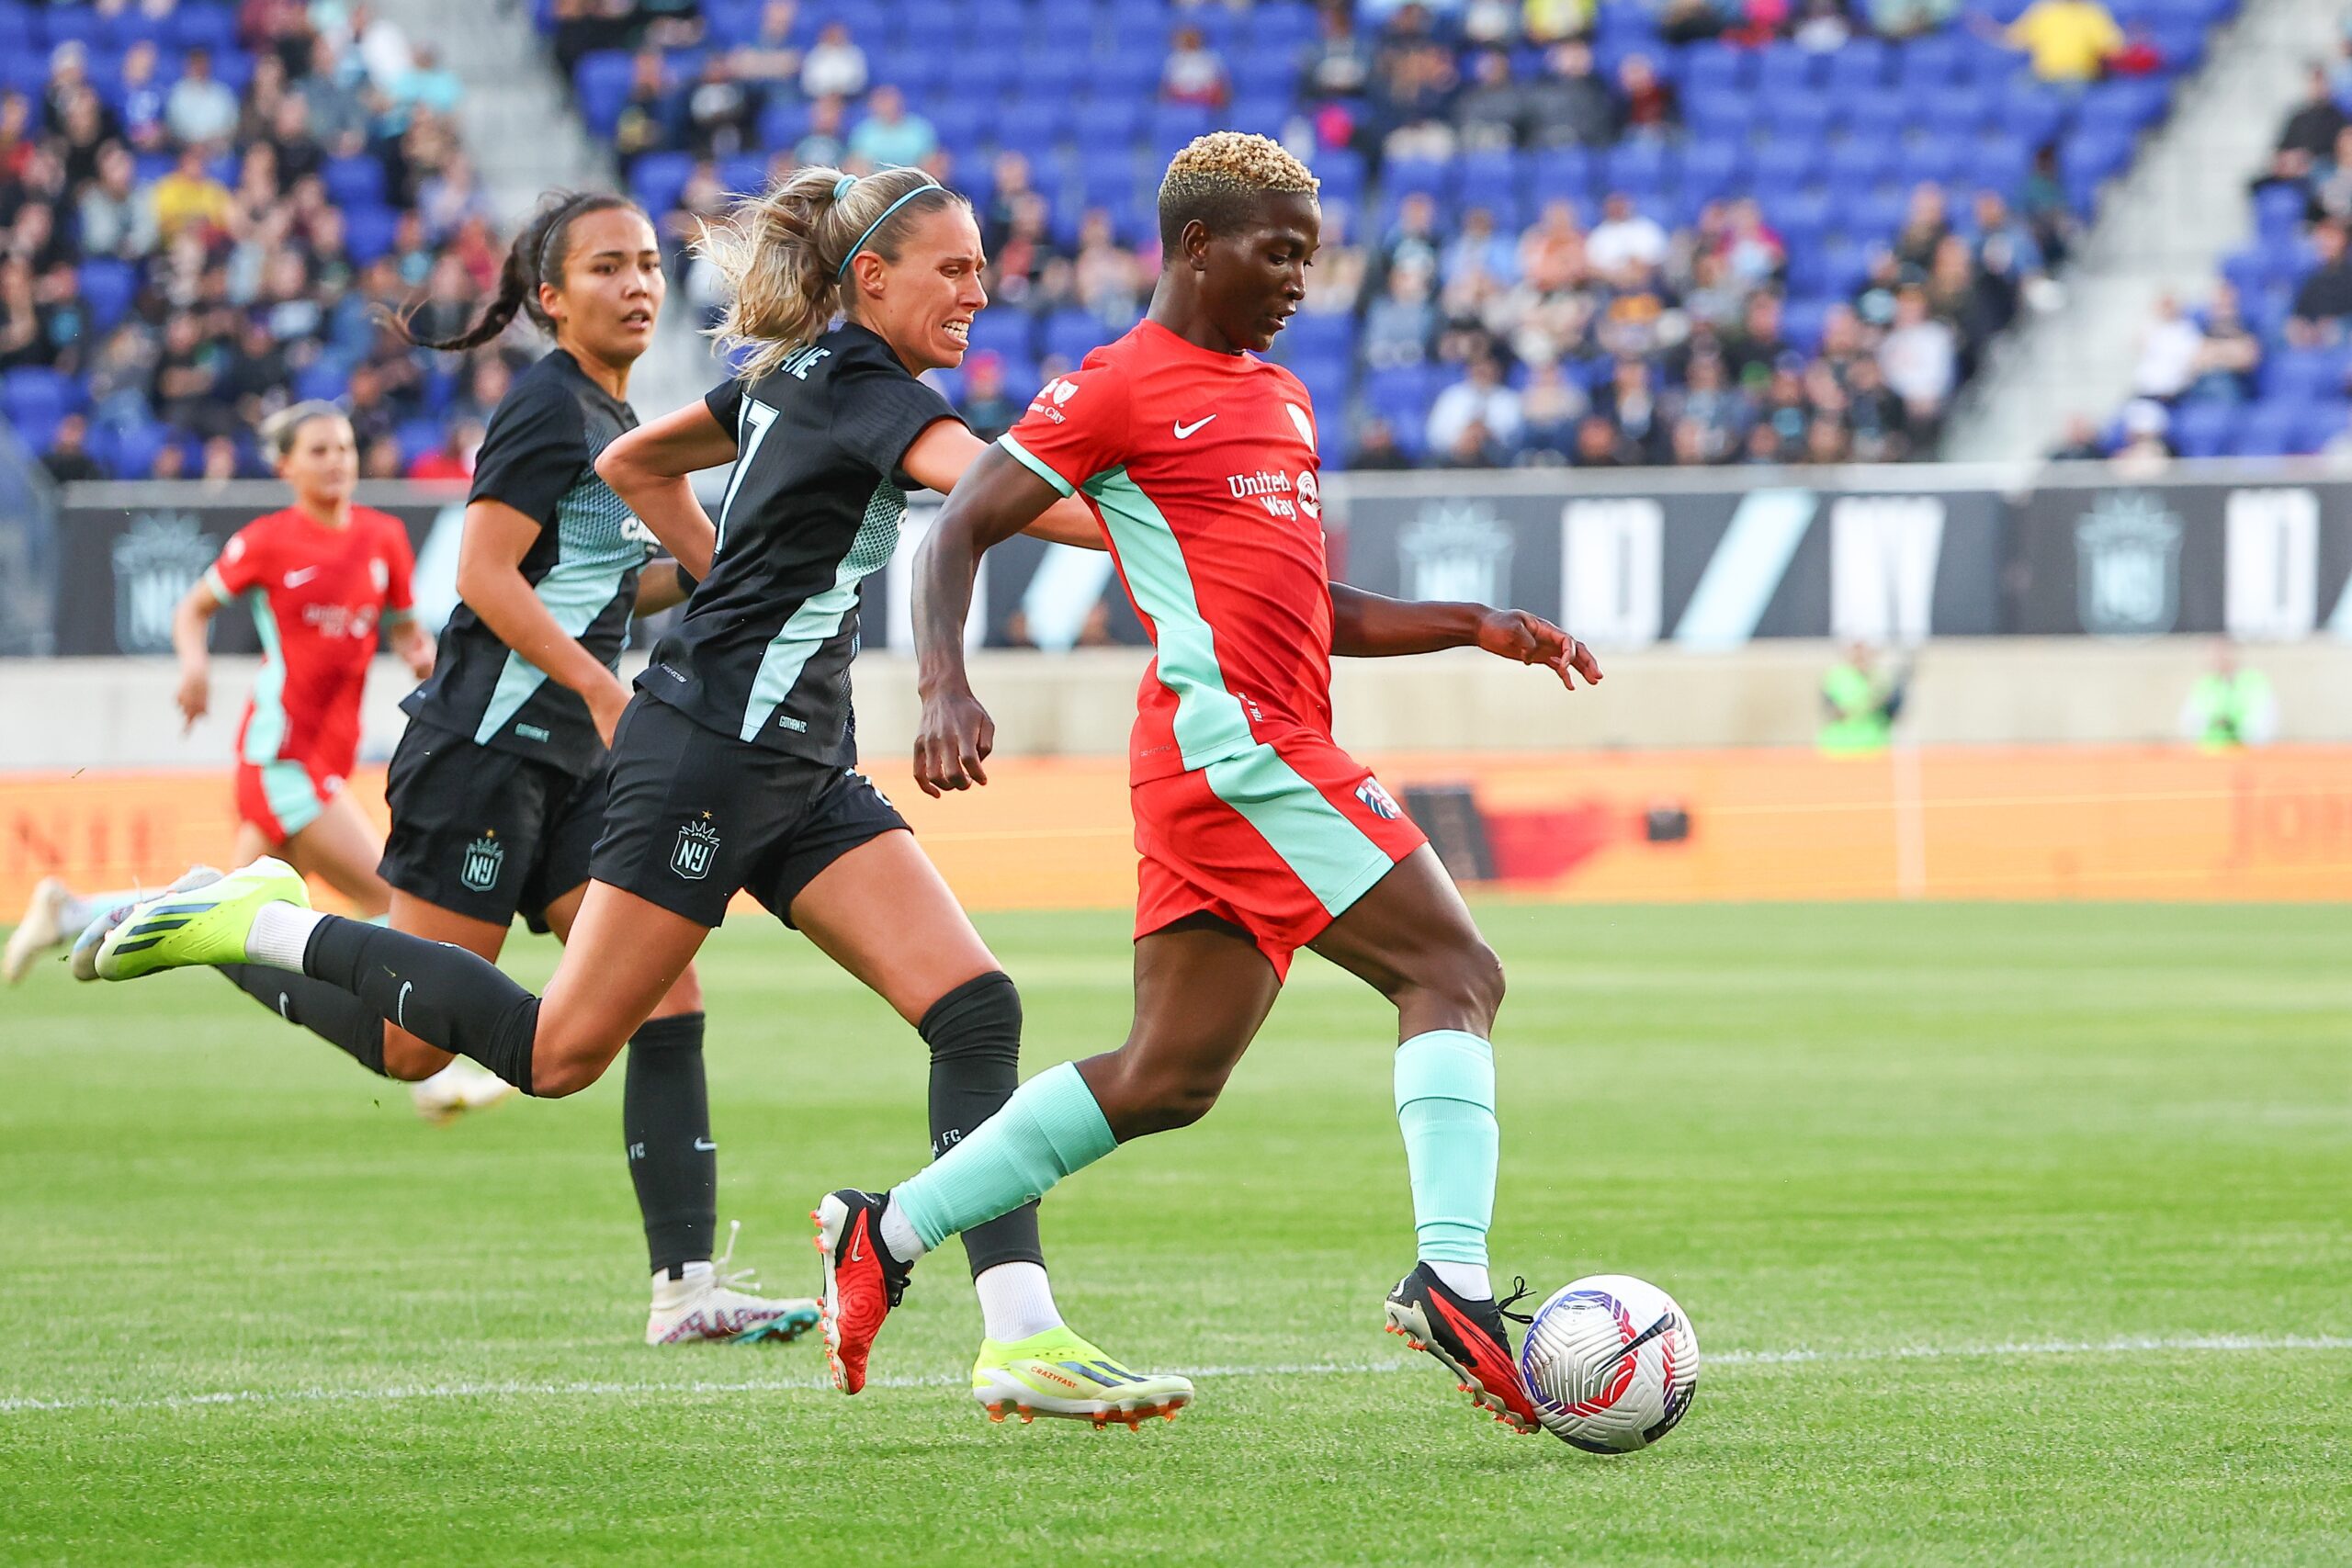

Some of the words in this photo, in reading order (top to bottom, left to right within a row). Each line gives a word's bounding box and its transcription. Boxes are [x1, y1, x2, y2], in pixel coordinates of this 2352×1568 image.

[1045, 407, 1066, 424] City
[1227, 469, 1292, 499] United
[1260, 495, 1297, 522] Way
[676, 839, 709, 873] NY
[467, 853, 495, 885] NY
[942, 1128, 963, 1146] FC
[629, 1142, 646, 1160] FC
[1030, 1366, 1079, 1389] CRAZYFAST
